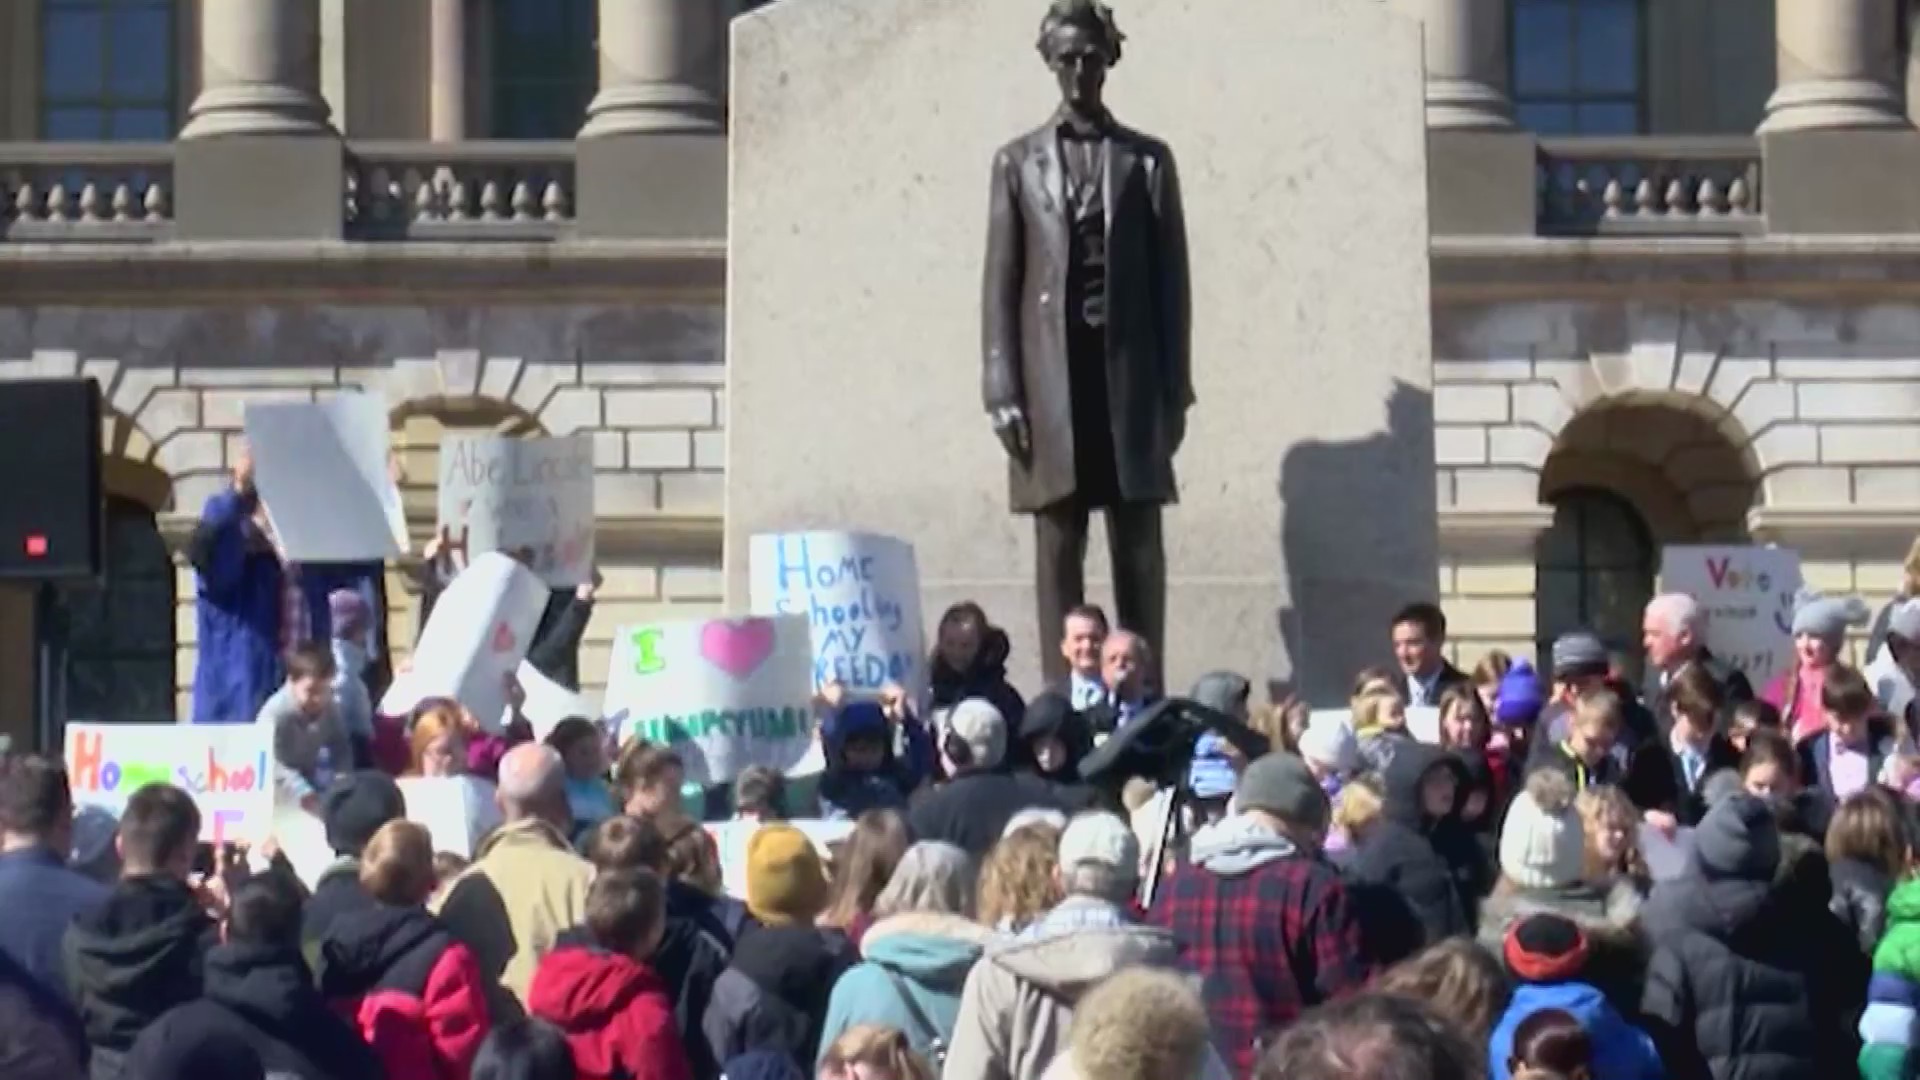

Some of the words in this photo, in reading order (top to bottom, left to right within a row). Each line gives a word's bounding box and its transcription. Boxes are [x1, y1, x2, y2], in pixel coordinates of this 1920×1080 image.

[447, 440, 503, 486] Abe
[632, 628, 666, 675] I
[72, 731, 266, 794] Hoschool
